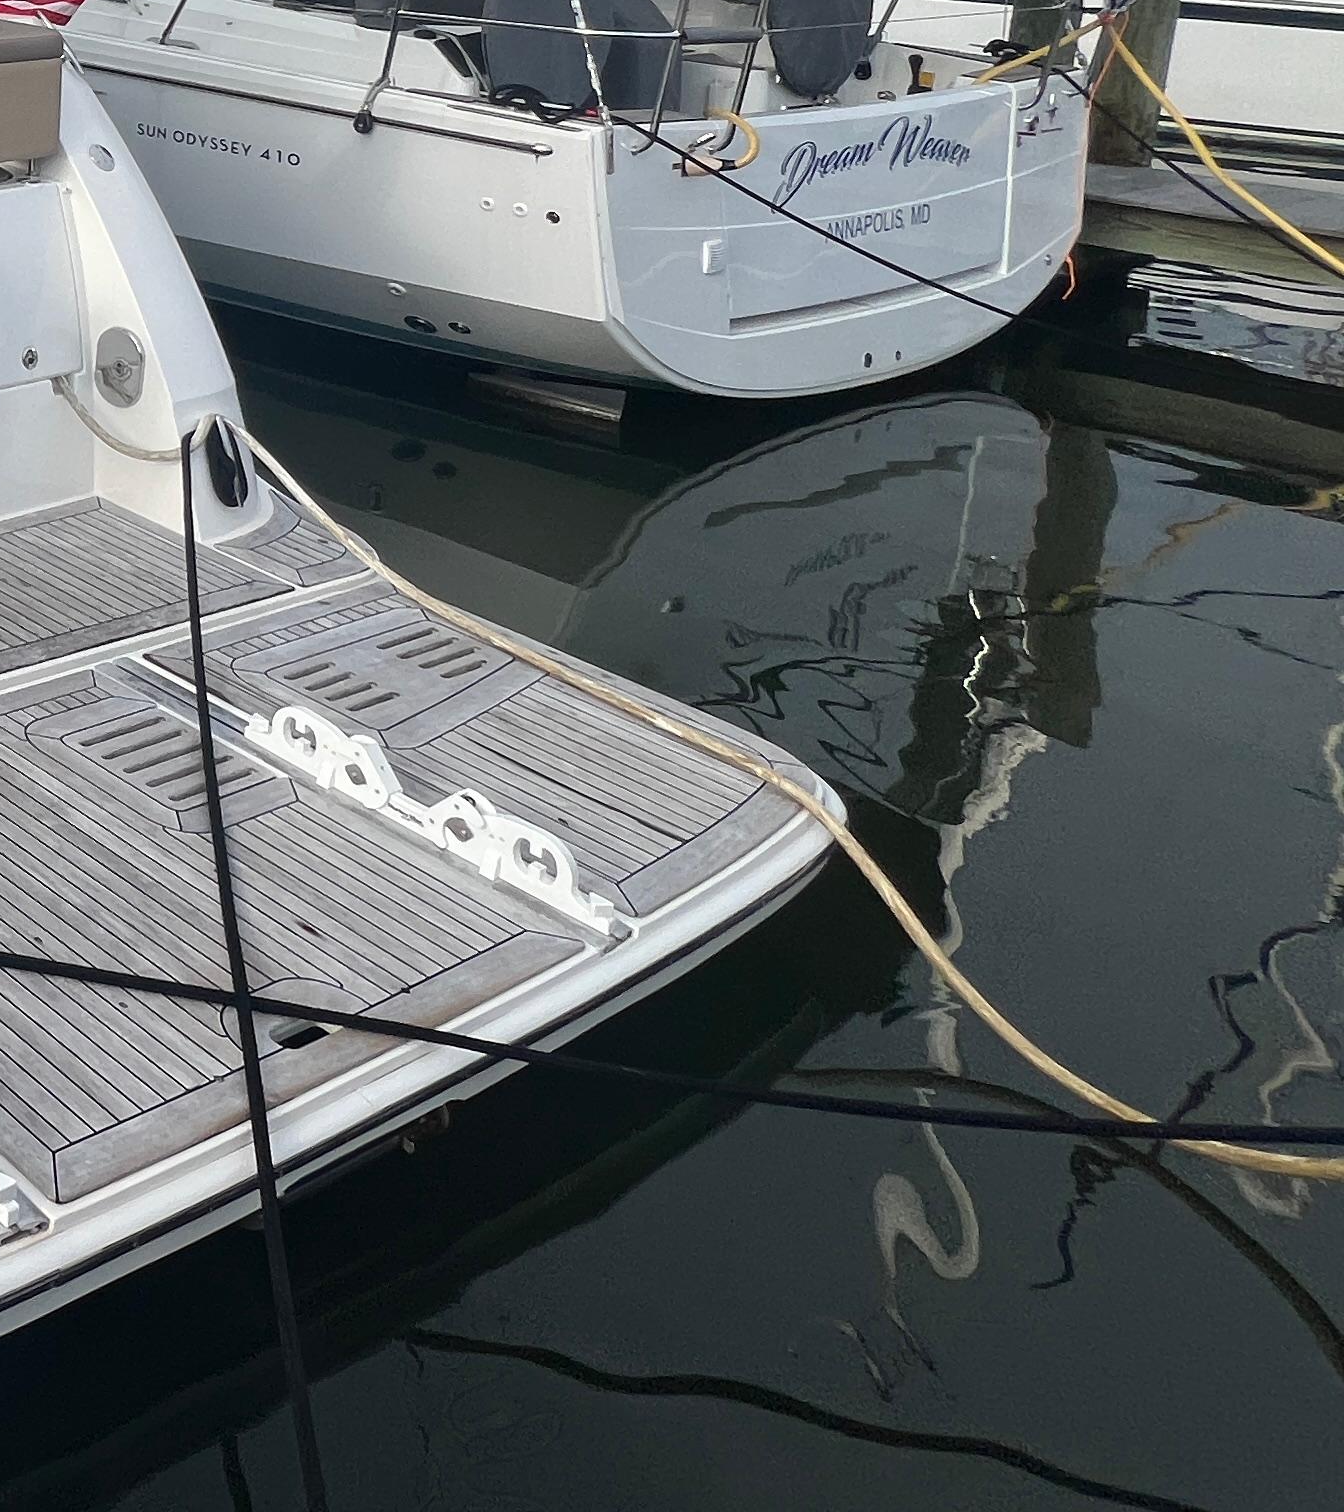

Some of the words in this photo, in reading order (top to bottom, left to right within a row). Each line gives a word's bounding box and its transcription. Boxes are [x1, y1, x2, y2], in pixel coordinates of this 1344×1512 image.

[136, 122, 167, 139] SUN
[172, 129, 252, 156] ODYSSEY
[260, 148, 301, 166] 410
[771, 141, 875, 214] Dream
[877, 114, 971, 172] Weaver
[910, 203, 931, 226] MD
